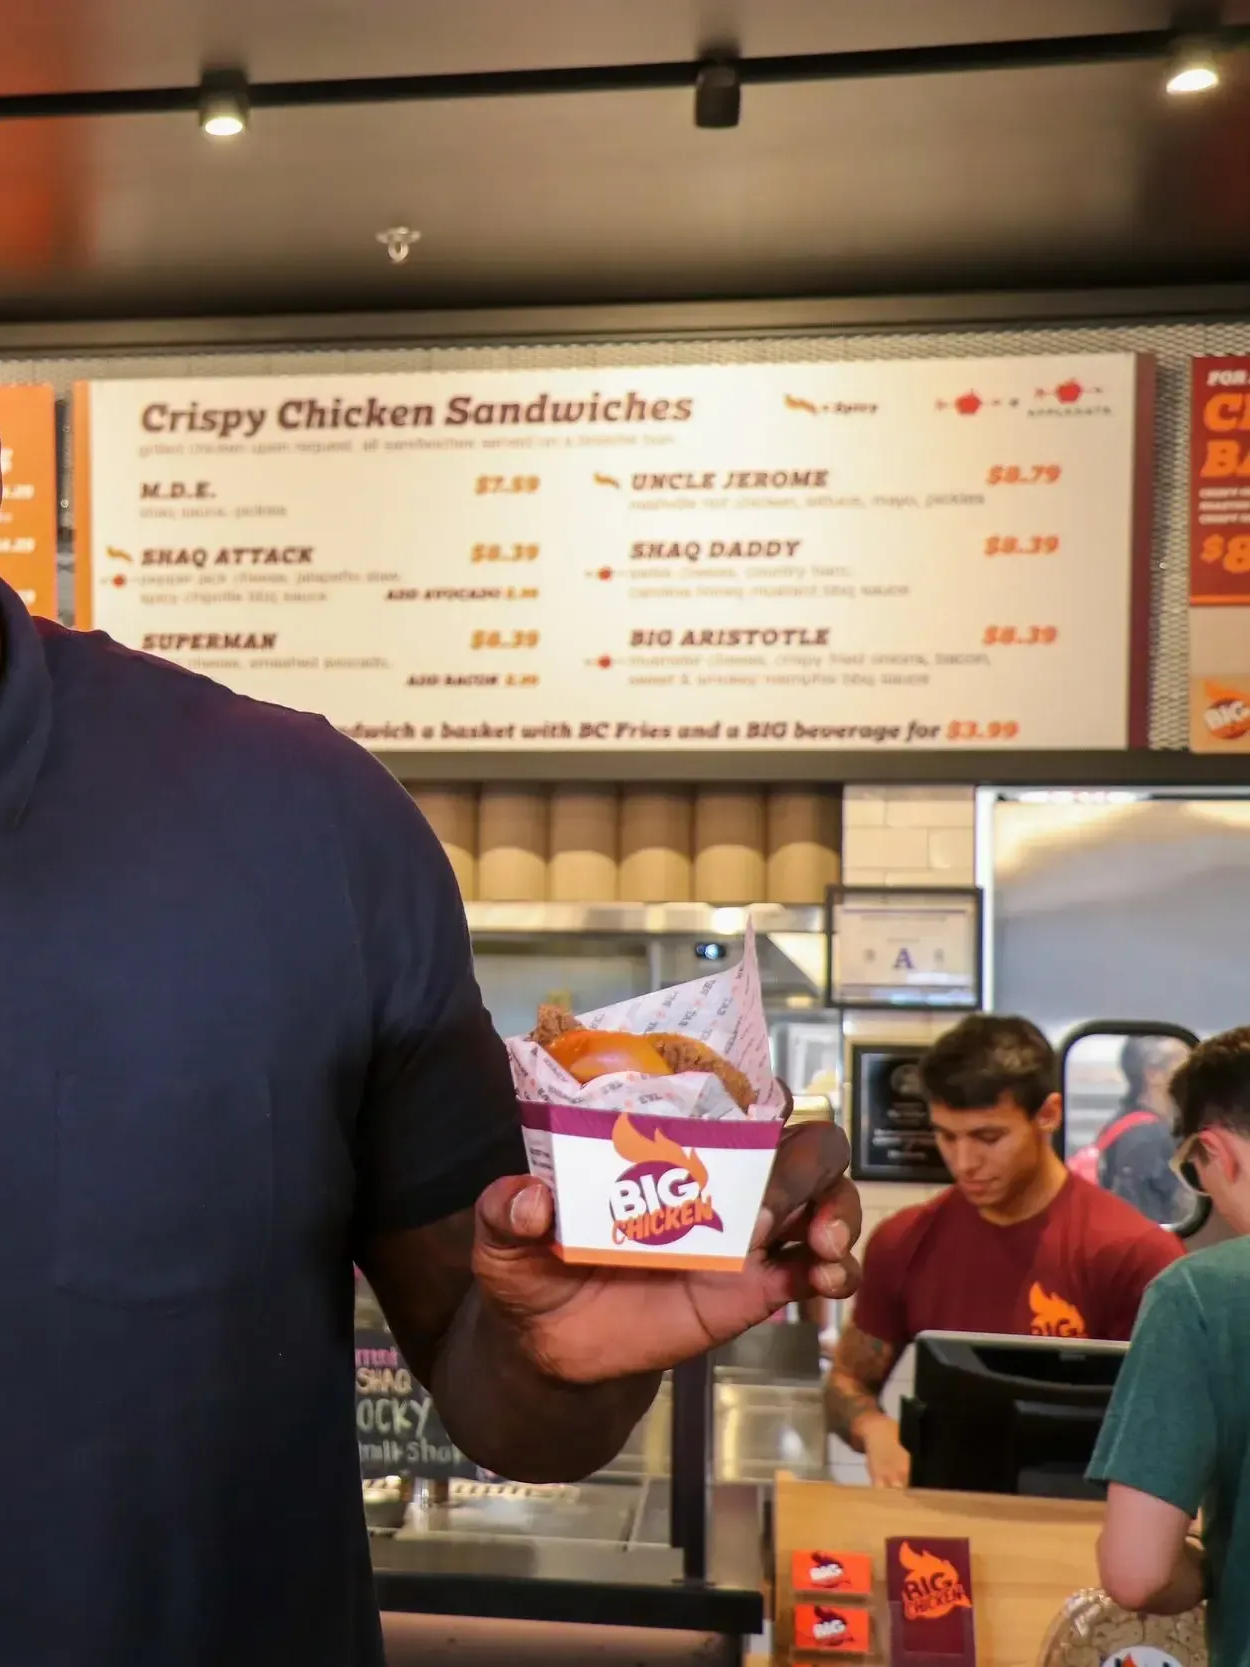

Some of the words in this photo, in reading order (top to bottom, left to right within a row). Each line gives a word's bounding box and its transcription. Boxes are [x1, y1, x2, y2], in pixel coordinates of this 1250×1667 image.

[141, 400, 267, 438] Crispy
[277, 394, 435, 431] Chicken
[444, 388, 694, 427] Sandwiches
[631, 472, 716, 491] UNCLE
[722, 470, 830, 489] JEROME
[985, 464, 1062, 485] $8.79
[140, 481, 217, 500] M.D.E.
[141, 548, 208, 568] SHAQ
[214, 545, 315, 566] ATTACK
[630, 541, 701, 562] SHAQ
[707, 539, 802, 560] DADDY
[981, 535, 1060, 556] $8.39
[141, 632, 278, 651] SUPERMAN
[630, 629, 674, 647] BIG
[679, 628, 831, 647] ARISTOTLE
[421, 728, 434, 739] a
[439, 720, 516, 740] basket
[521, 720, 573, 739] with
[578, 721, 611, 739] BC
[614, 721, 672, 739] Fries
[677, 721, 721, 739] and
[726, 727, 740, 738] a
[746, 721, 788, 738] BIG
[793, 720, 902, 743] beverage
[903, 720, 942, 743] for
[946, 720, 1020, 740] $3.99
[891, 947, 916, 970] A
[614, 1167, 700, 1221] BIG
[612, 1195, 713, 1246] CHICKEN
[904, 1572, 953, 1601] BIG
